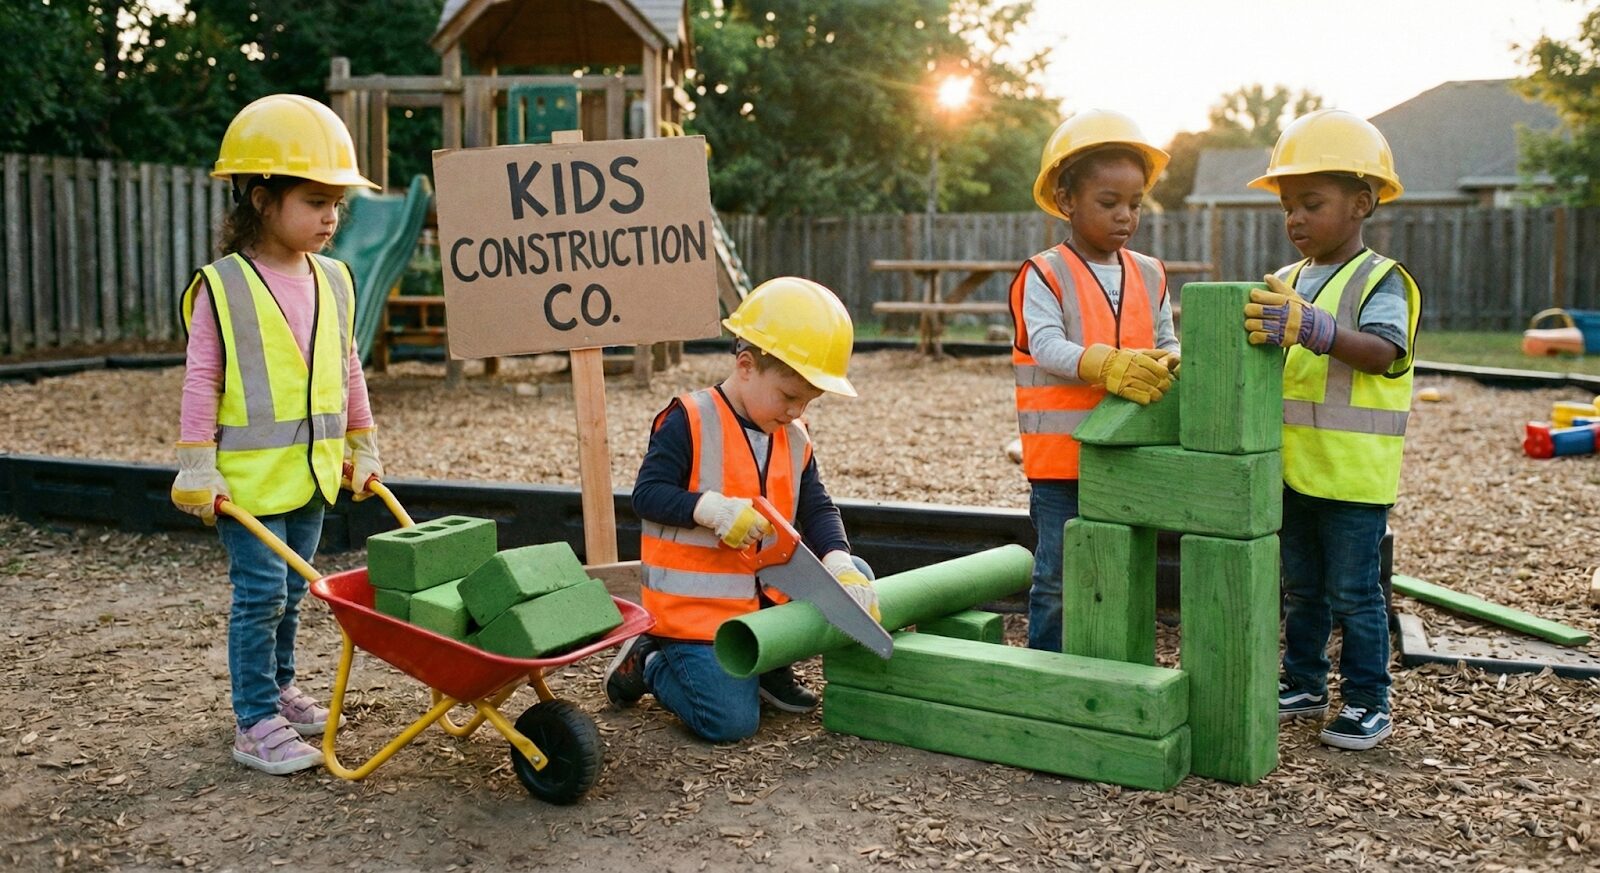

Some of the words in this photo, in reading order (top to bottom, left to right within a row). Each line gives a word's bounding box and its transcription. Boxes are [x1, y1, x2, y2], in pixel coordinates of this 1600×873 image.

[506, 156, 645, 220] KIDS
[450, 220, 707, 283] CONSTRUCTION
[543, 283, 622, 332] CO.
